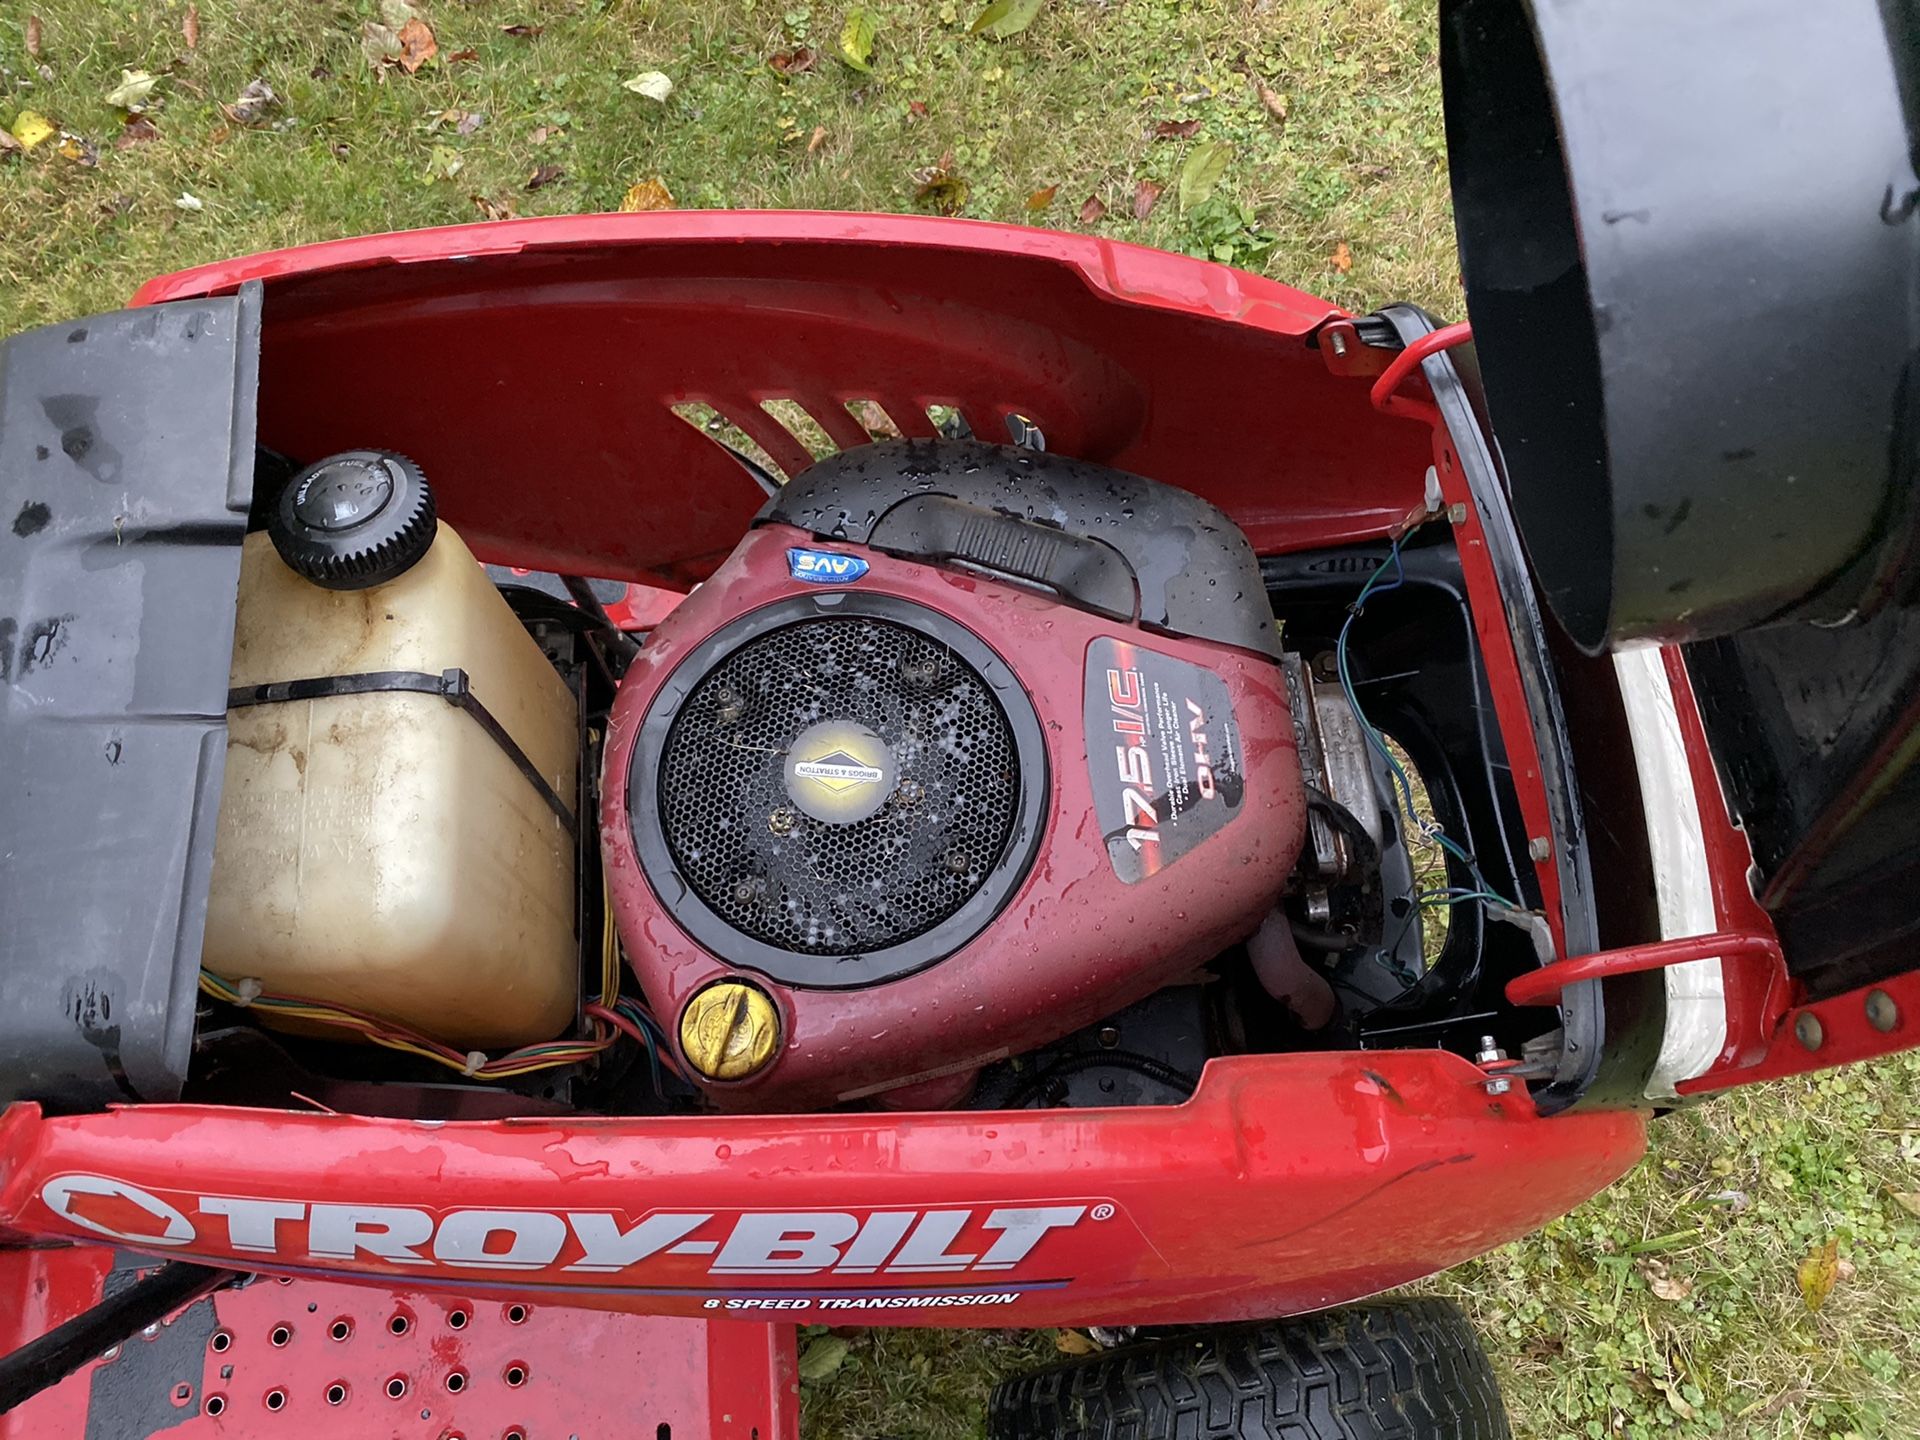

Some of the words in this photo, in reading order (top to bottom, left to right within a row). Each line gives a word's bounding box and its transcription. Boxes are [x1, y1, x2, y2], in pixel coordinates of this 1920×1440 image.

[797, 555, 849, 574] AVS
[1153, 682, 1165, 729] Performance
[1161, 692, 1169, 706] Life
[1164, 707, 1173, 734] Longer
[1170, 700, 1180, 729] Cleaner
[1160, 730, 1168, 750] Valve
[1174, 730, 1182, 742] Air
[1169, 740, 1177, 766] Sleeve
[1176, 744, 1186, 775] Element
[1184, 697, 1215, 800] OHV
[799, 766, 840, 775] STRATTON
[848, 770, 878, 778] BRIGGS
[1162, 752, 1173, 788] Overhead
[1175, 785, 1183, 804] Cast
[1180, 776, 1189, 794] Dual
[1115, 745, 1160, 851] 17.5
[1168, 789, 1178, 820] Durable
[703, 1299, 721, 1309] 8
[726, 1299, 812, 1310] SPEED
[818, 1292, 1021, 1310] TRANSMISSION
